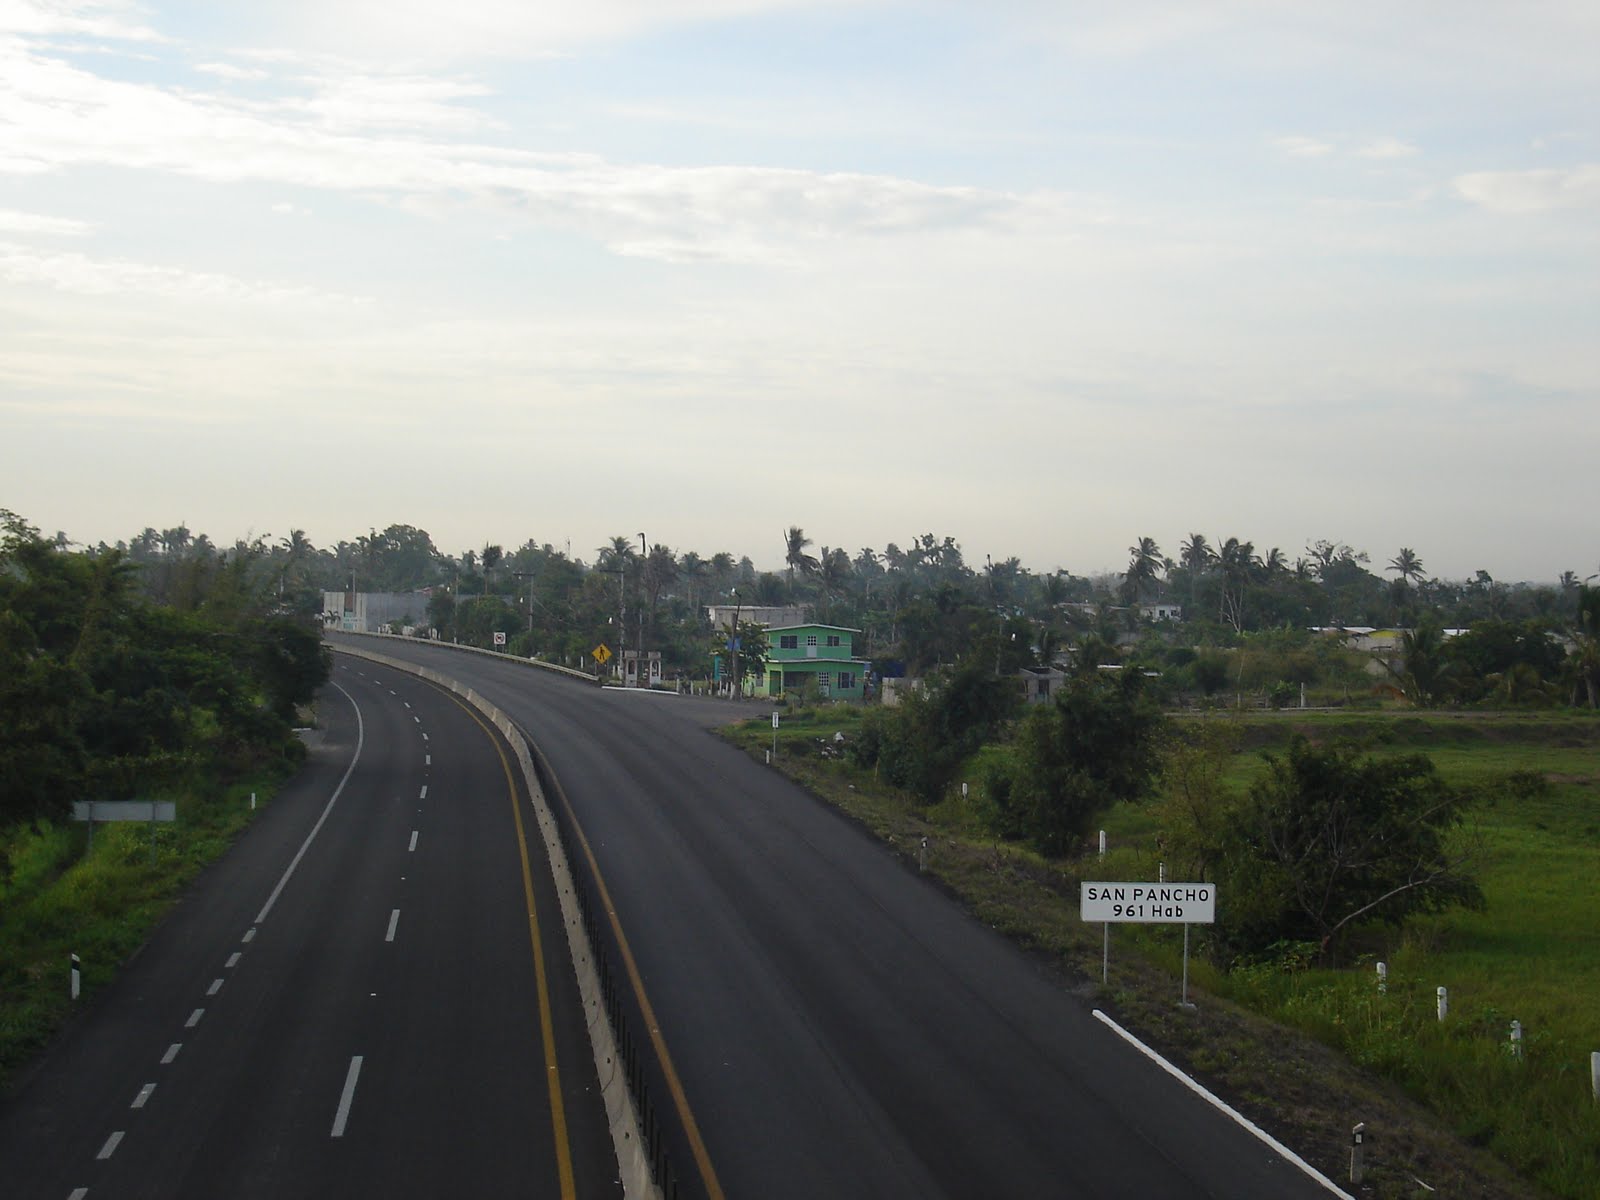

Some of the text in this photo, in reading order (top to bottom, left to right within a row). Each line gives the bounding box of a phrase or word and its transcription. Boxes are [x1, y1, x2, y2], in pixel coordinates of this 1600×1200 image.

[1088, 887, 1209, 902] SAN PANCHO
[1112, 904, 1183, 918] 961 Hab
